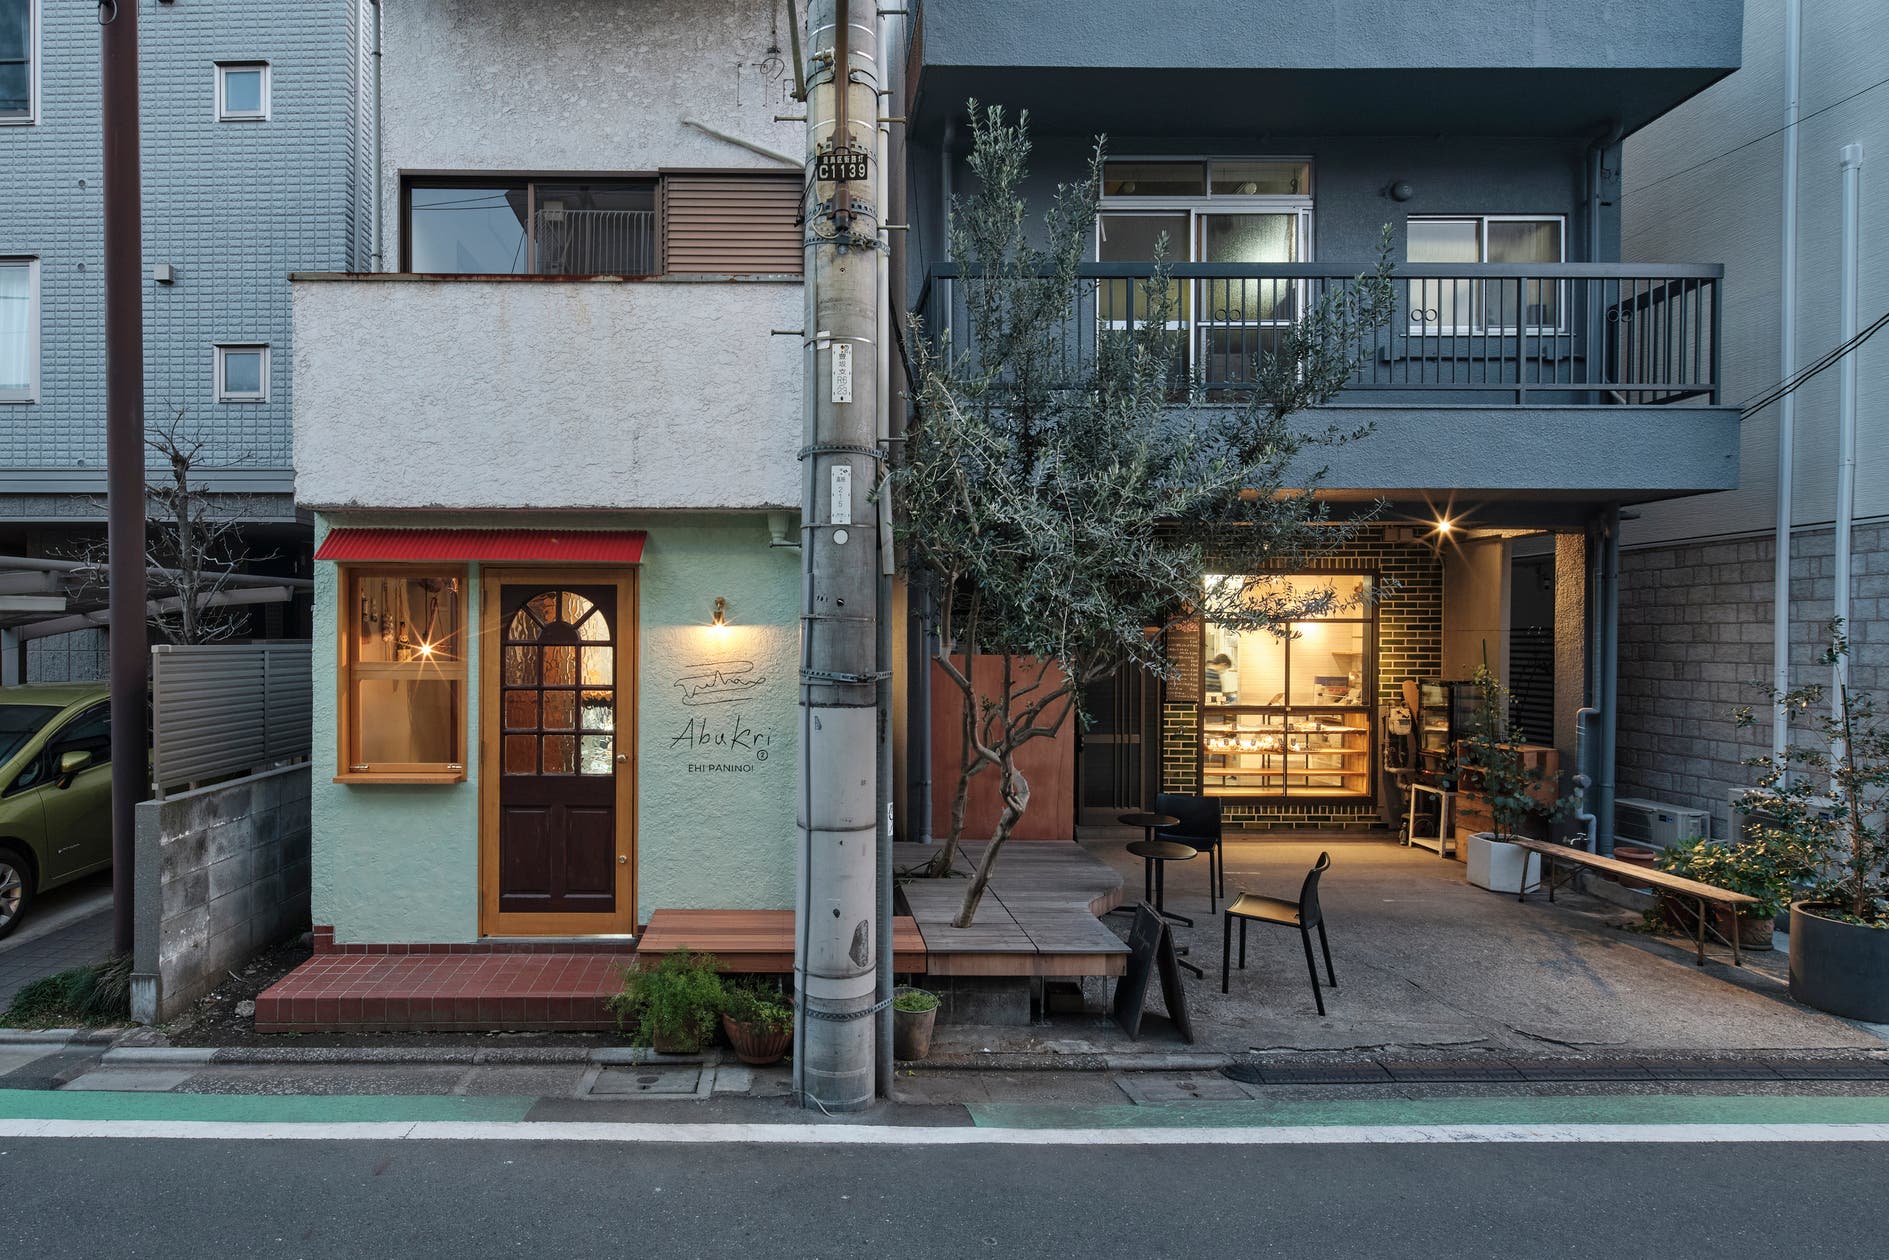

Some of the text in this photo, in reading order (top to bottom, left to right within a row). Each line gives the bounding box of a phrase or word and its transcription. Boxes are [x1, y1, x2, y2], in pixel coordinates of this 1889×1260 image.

[819, 164, 866, 179] C1139
[688, 763, 754, 773] EHI PANINO!
